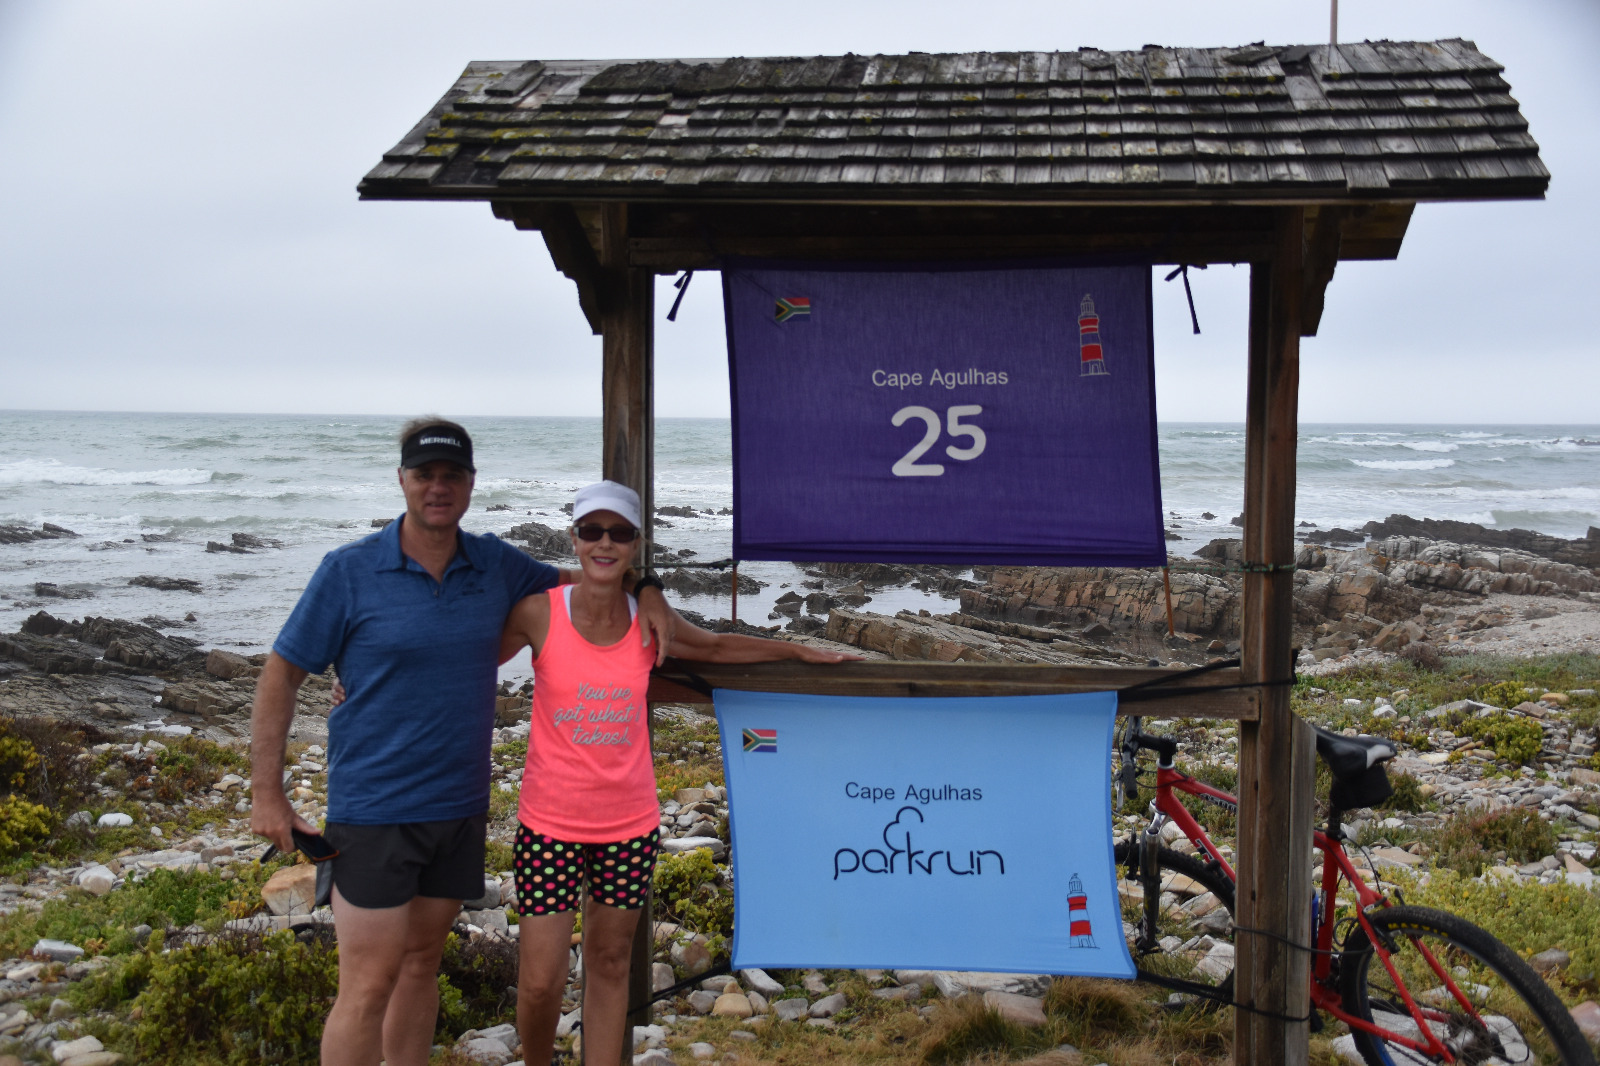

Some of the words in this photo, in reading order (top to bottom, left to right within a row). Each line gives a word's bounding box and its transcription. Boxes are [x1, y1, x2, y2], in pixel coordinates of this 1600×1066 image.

[872, 369, 923, 391] Cape
[930, 368, 1009, 390] Agulhas
[420, 436, 462, 448] MERRELL
[891, 404, 987, 477] 25
[576, 682, 633, 700] You've
[553, 702, 586, 728] got
[588, 702, 635, 723] what
[845, 781, 896, 804] Cape
[904, 784, 983, 805] Agulhas
[833, 806, 1005, 881] parkrun
